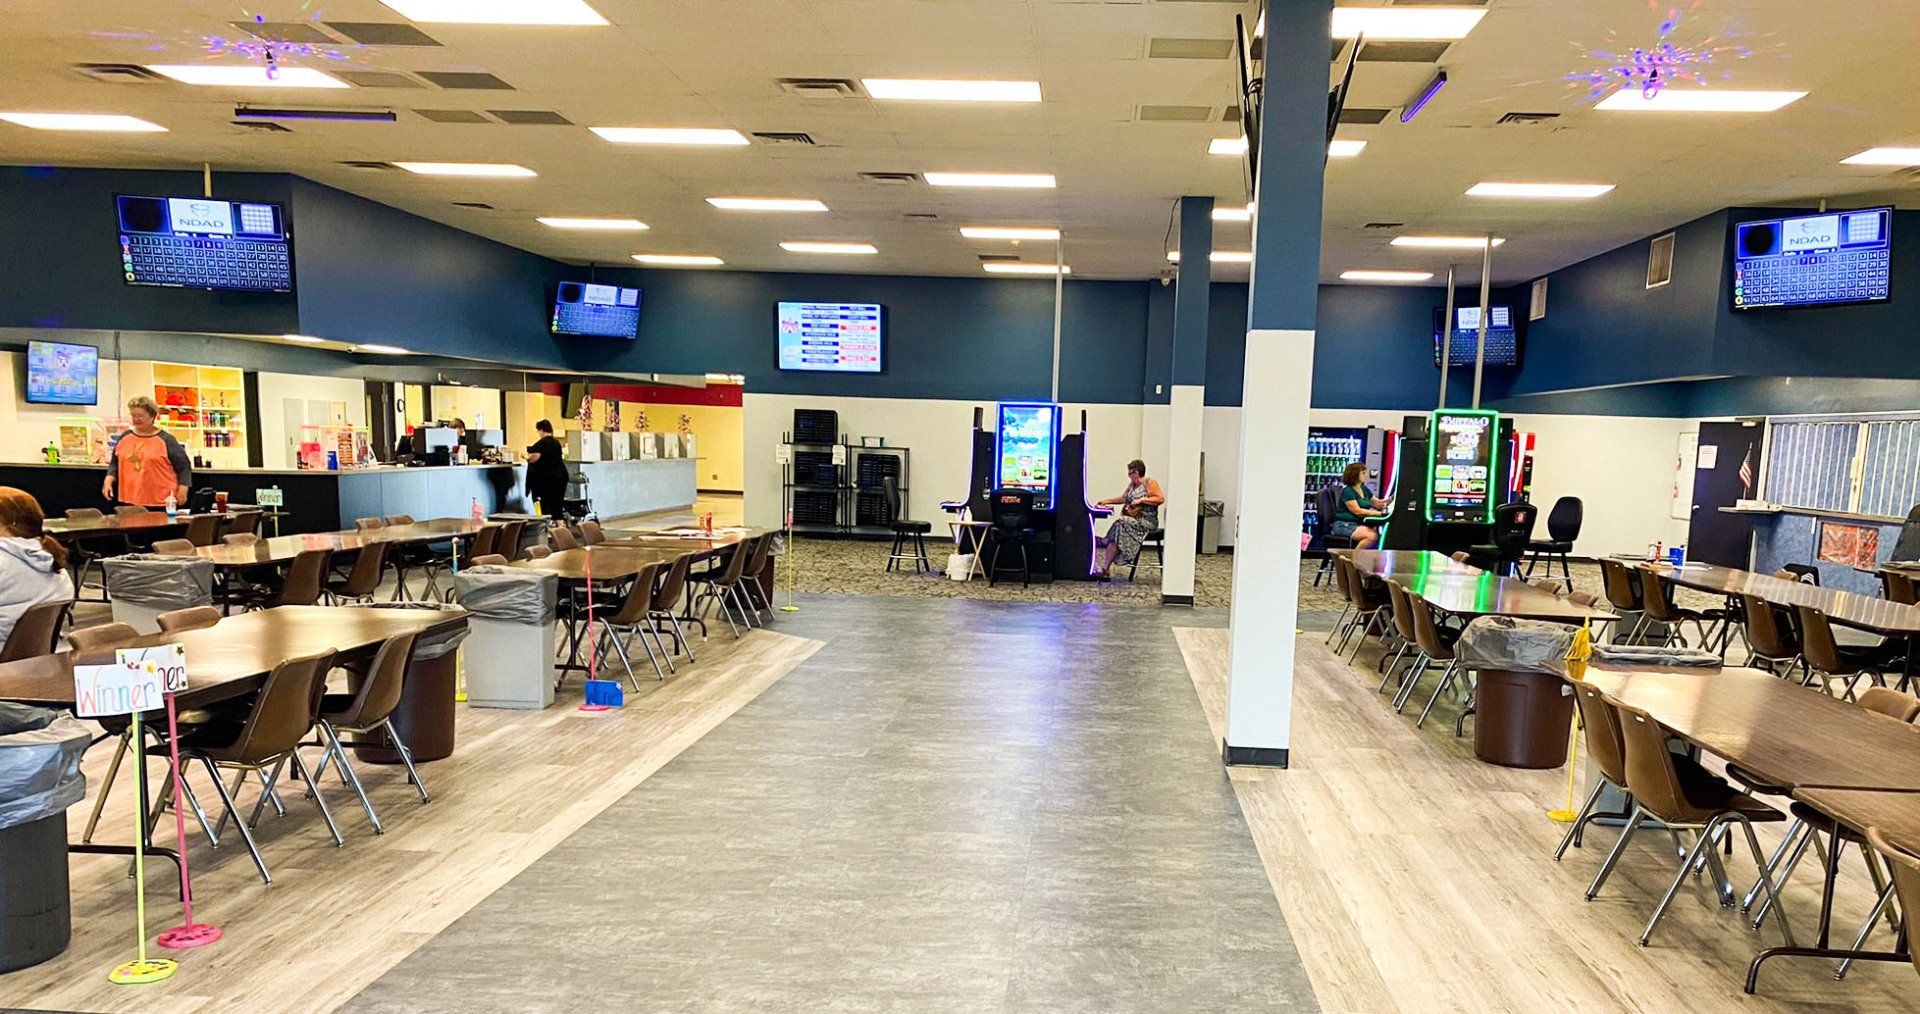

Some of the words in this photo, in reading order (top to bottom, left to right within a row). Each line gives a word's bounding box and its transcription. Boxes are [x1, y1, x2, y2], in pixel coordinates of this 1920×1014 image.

[179, 219, 224, 228] NDAD
[1790, 235, 1831, 245] NDAD
[77, 667, 155, 714] Winner
